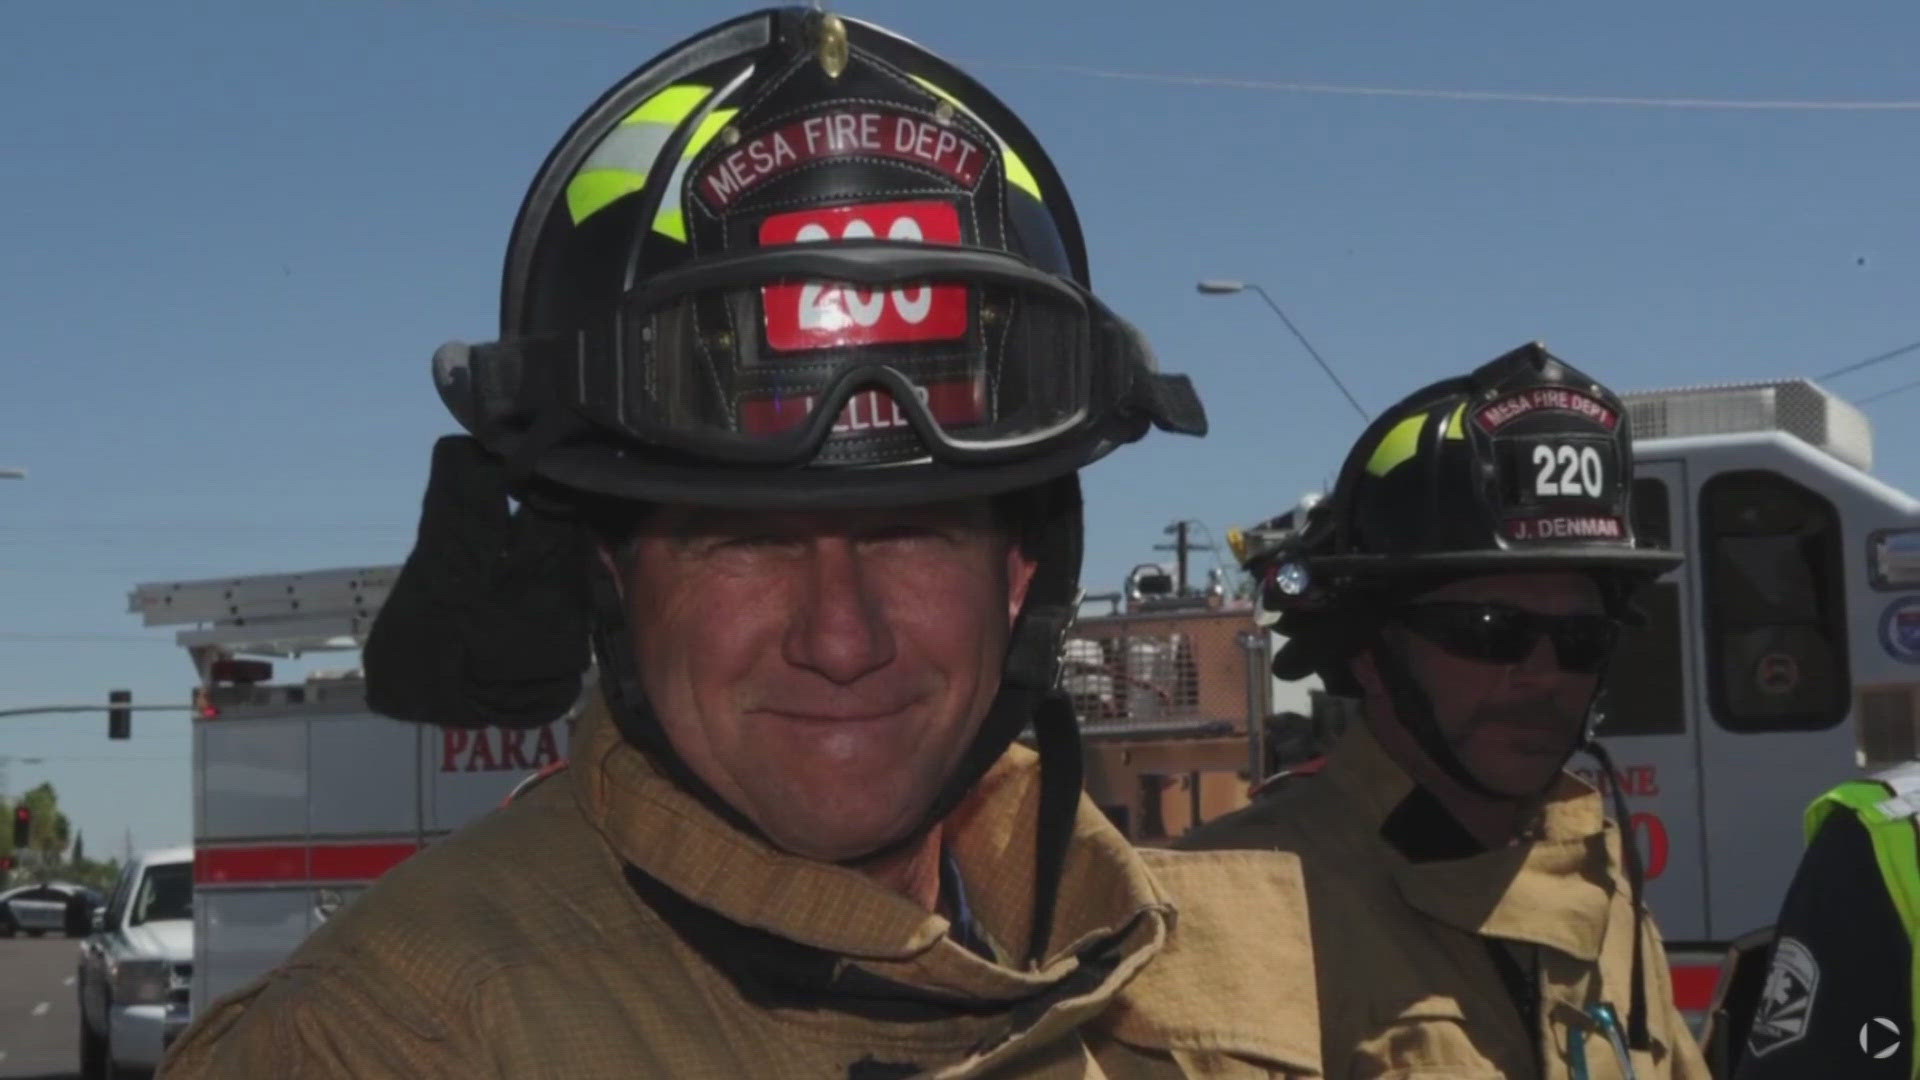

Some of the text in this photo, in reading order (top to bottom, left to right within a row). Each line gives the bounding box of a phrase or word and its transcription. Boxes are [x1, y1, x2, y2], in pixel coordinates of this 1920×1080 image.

[708, 113, 976, 204] MESA FIRE DEPT.
[1485, 395, 1532, 426] MESA
[1533, 389, 1569, 408] FIRE
[1533, 445, 1602, 498] 220
[1514, 516, 1619, 540] J. DENMAN
[441, 722, 574, 772] PARA
